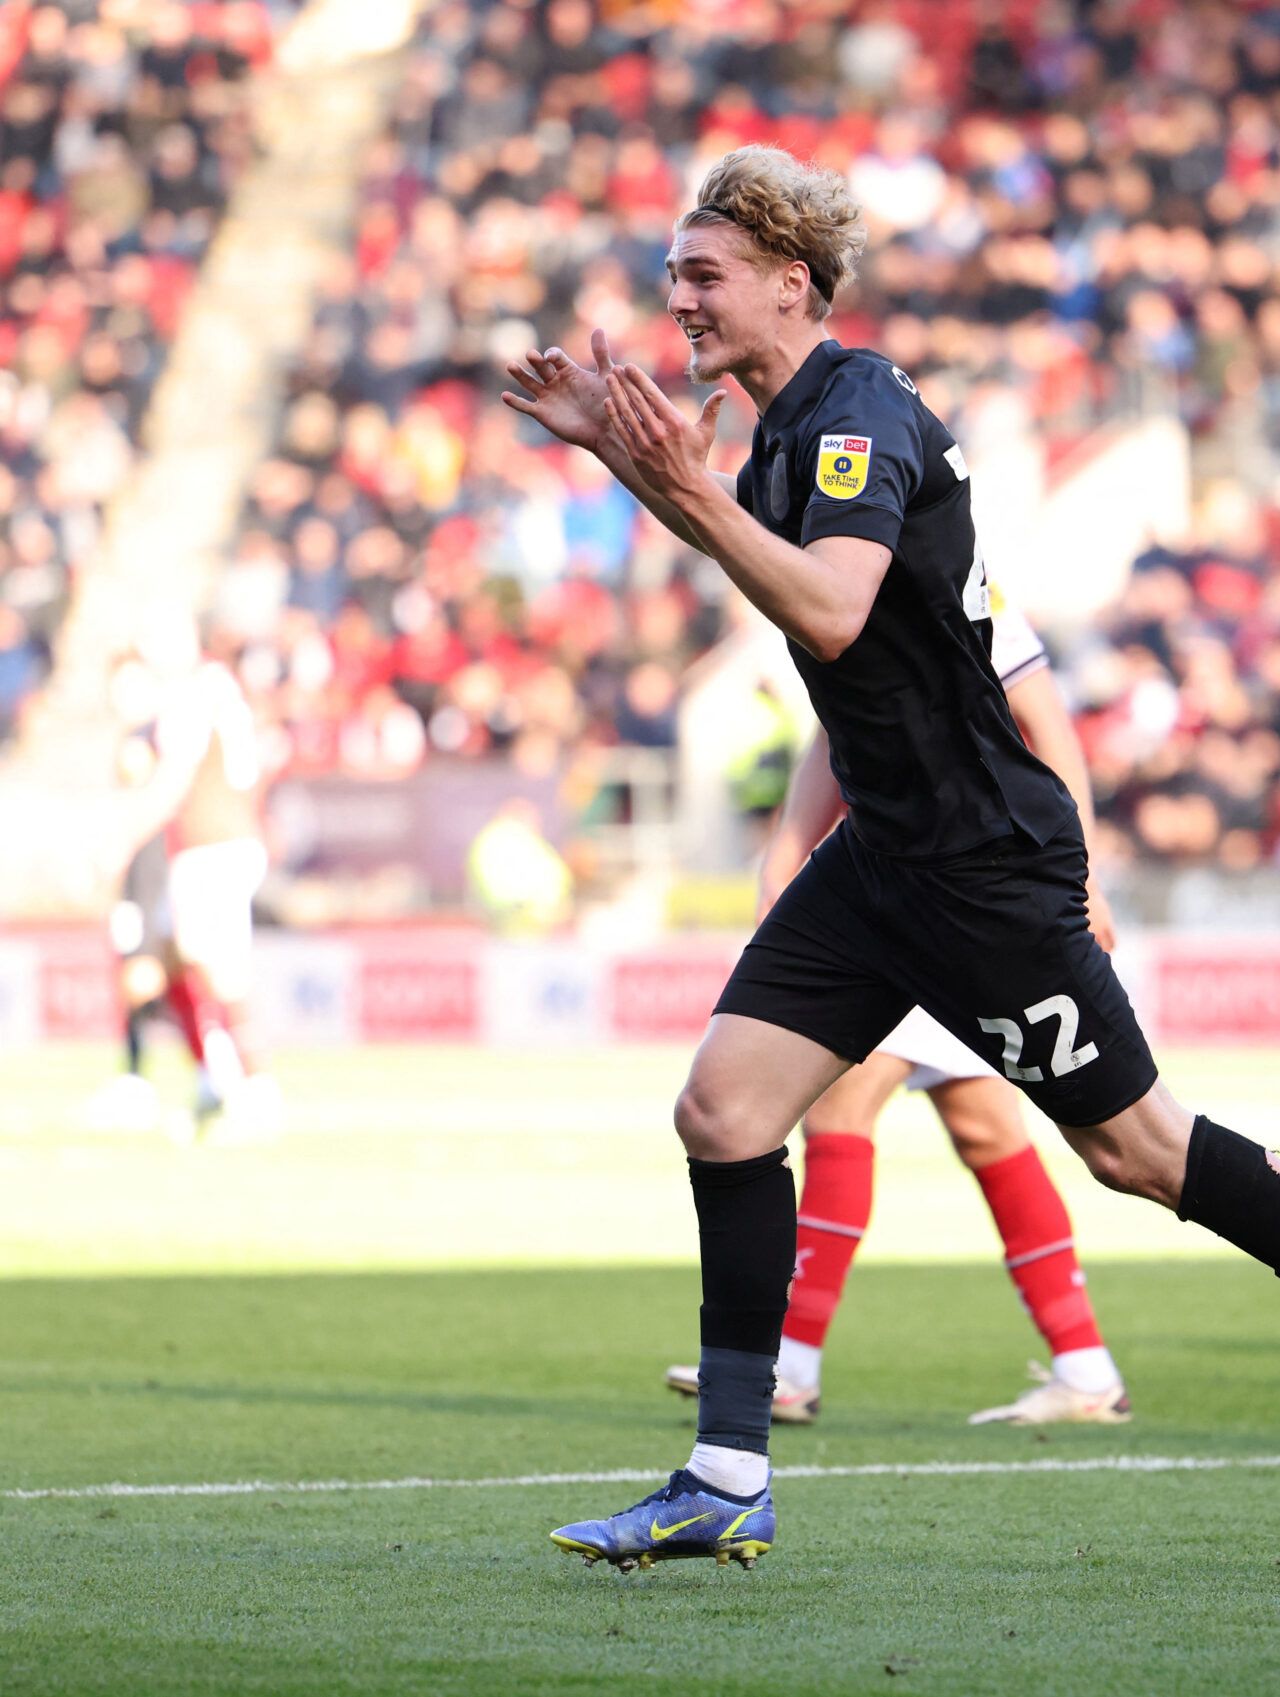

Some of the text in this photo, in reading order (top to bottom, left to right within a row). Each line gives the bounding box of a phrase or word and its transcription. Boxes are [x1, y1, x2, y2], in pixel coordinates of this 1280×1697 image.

[824, 439, 866, 451] sky bet
[842, 475, 859, 484] TIME
[835, 481, 858, 489] THINK
[977, 994, 1100, 1082] 22
